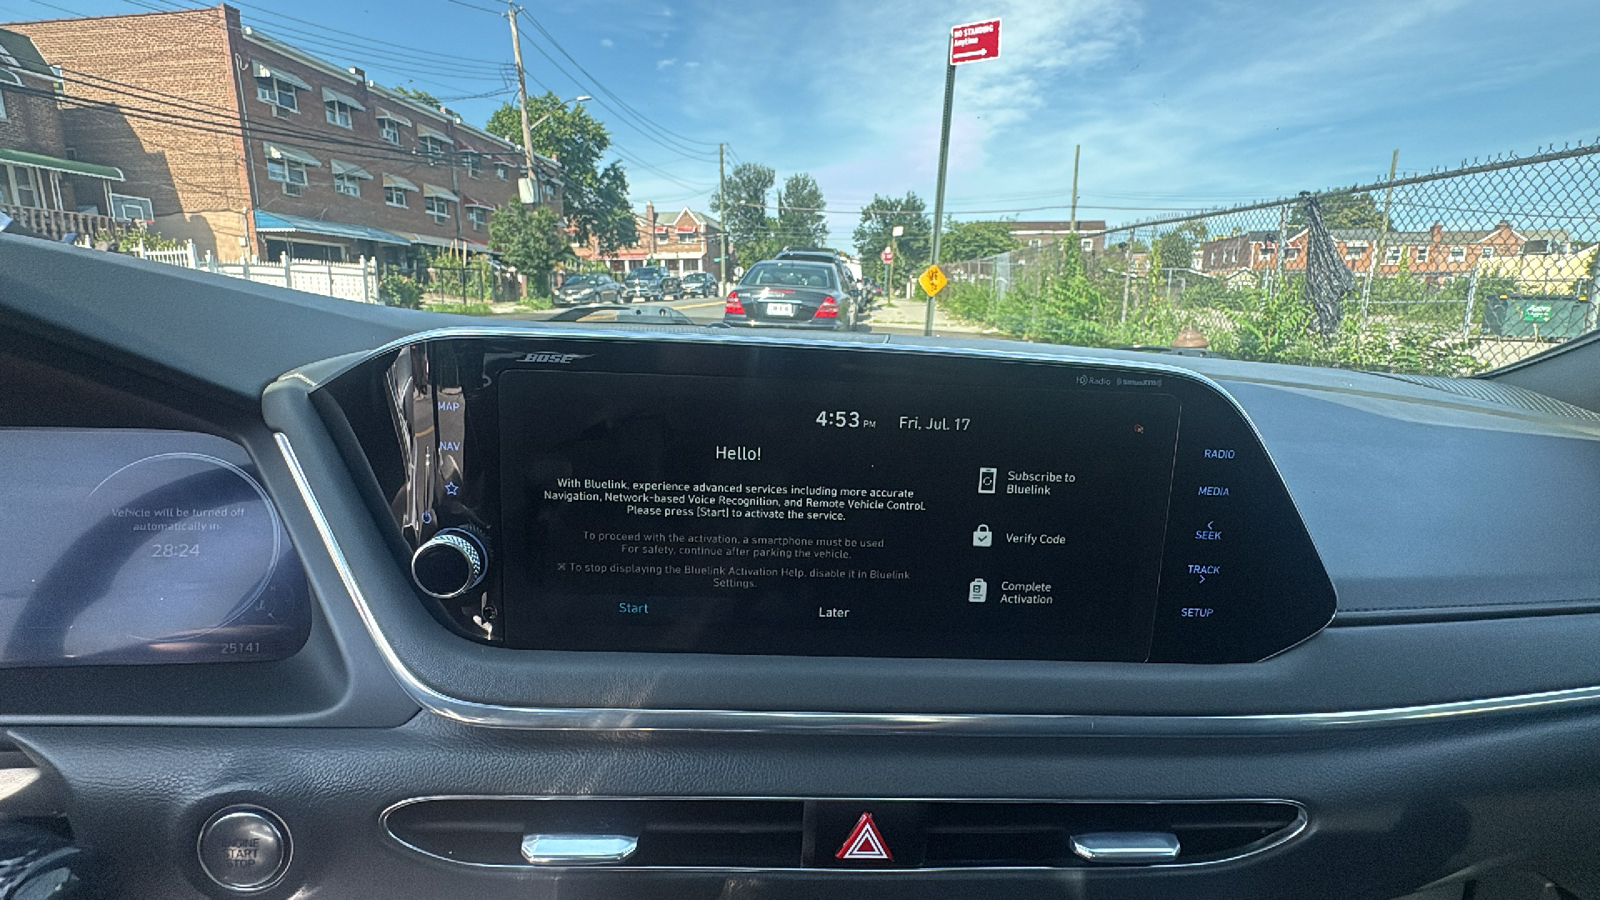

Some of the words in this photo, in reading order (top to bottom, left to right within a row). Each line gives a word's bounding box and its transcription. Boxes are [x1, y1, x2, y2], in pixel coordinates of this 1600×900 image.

[517, 353, 573, 364] BOSE
[1088, 377, 1111, 386] Radio
[438, 402, 460, 412] MAP
[816, 410, 860, 428] 4:53
[863, 420, 876, 428] PM
[900, 416, 922, 430] Fri,
[926, 418, 950, 430] Jul.
[954, 418, 970, 430] 17
[440, 442, 460, 451] NAV
[716, 446, 760, 460] Hello!
[1204, 449, 1236, 459] RADIO
[1008, 470, 1062, 482] Subscribe
[1064, 472, 1076, 482] to
[557, 478, 581, 488] With
[584, 479, 630, 490] Bluelink,
[633, 481, 690, 492] experience
[693, 482, 742, 493] advanced
[746, 484, 788, 494] services
[791, 484, 838, 497] including
[840, 488, 868, 496] more
[870, 489, 914, 498] accurate
[1006, 484, 1050, 495] Bluelink
[1198, 486, 1230, 496] MEDIA
[544, 490, 602, 502] Navigation,
[605, 492, 685, 504] Network-based
[688, 494, 716, 504] Voice
[718, 496, 780, 508] Recognition,
[784, 498, 802, 508] and
[806, 498, 846, 508] Remote
[848, 500, 884, 510] Vehicle
[112, 508, 150, 518] Vehicle
[152, 508, 174, 517] will
[176, 508, 188, 517] be
[192, 508, 228, 517] turned
[230, 508, 245, 517] off
[627, 505, 662, 515] Please
[664, 508, 694, 517] press
[696, 508, 729, 518] [Start]
[732, 510, 742, 518] to
[744, 509, 784, 518] activate
[788, 510, 804, 519] the
[806, 511, 846, 520] service.
[133, 522, 206, 532] automatically
[583, 530, 596, 540] To
[598, 532, 640, 542] proceed
[644, 532, 666, 542] with
[668, 533, 685, 542] the
[752, 536, 813, 546] smartphone
[816, 538, 842, 546] must
[844, 538, 858, 548] be
[1006, 532, 1038, 545] Verify
[1040, 534, 1066, 544] Code
[1195, 530, 1222, 540] SEEK
[152, 543, 200, 558] 28:24
[622, 544, 640, 554] For
[642, 545, 676, 556] safety,
[679, 546, 722, 556] continue
[726, 546, 750, 556] after
[753, 548, 792, 558] parking
[794, 548, 811, 558] the
[814, 550, 852, 559] vehicle.
[570, 562, 582, 572] To
[585, 563, 606, 574] stop
[610, 564, 662, 575] displaying
[665, 564, 681, 574] the
[684, 566, 726, 575] Bluelink
[728, 566, 778, 576] Activation
[810, 568, 846, 578] disable
[848, 570, 856, 578] it
[858, 570, 867, 578] in
[870, 570, 910, 580] Bluelink
[1188, 564, 1220, 574] TRACK
[713, 578, 757, 589] Settings.
[1001, 582, 1052, 592] Complete
[1000, 594, 1052, 604] Activation
[619, 602, 648, 614] Start
[819, 606, 850, 618] Later
[1182, 608, 1214, 618] SETUP
[221, 642, 260, 654] 25141
